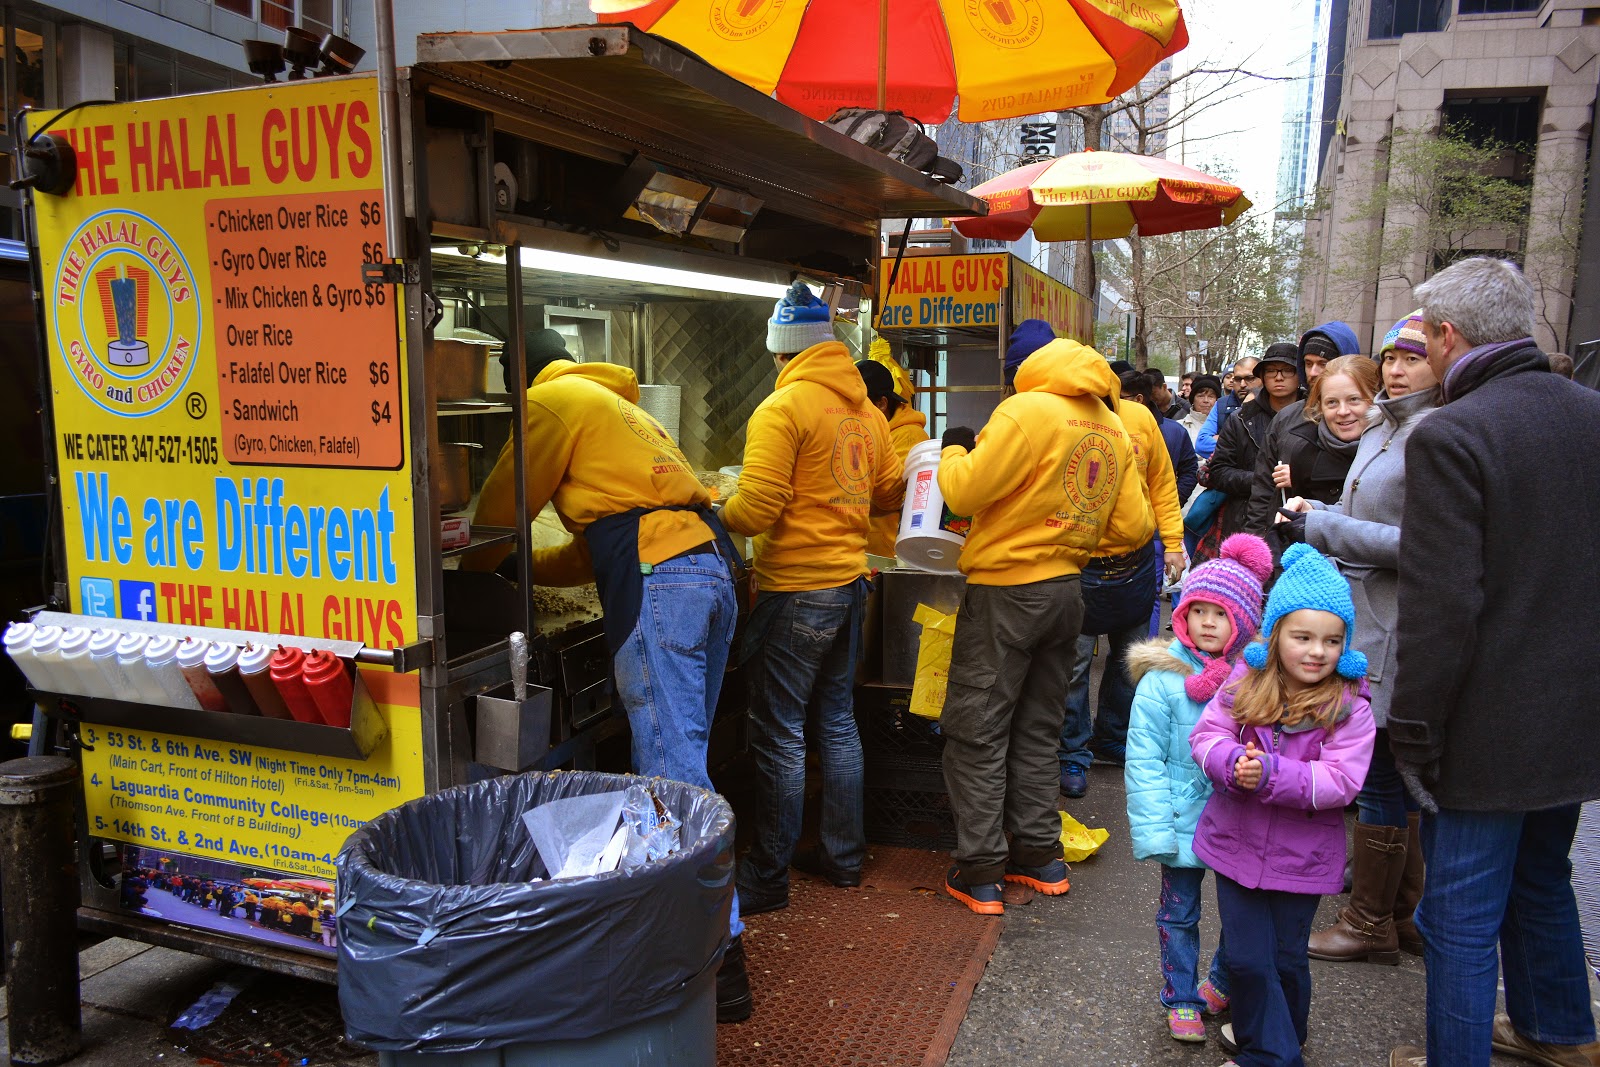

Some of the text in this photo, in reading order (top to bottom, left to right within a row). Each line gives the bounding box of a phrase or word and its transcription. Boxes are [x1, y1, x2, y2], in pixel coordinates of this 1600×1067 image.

[1130, 2, 1163, 27] GUYS
[48, 100, 373, 198] HE HALAL GUYS
[1039, 186, 1151, 203] THE HALAL GUYS
[218, 201, 381, 233] Chicken Over Rice $6
[59, 220, 190, 306] THE HALAL GUYS
[222, 241, 383, 276] Gyro Over Rice $6
[952, 257, 1004, 292] GUYS
[225, 283, 385, 312] Mix Chicken & Gyro $6
[882, 296, 1000, 326] are Differen
[227, 324, 293, 346] Over Rice
[70, 336, 191, 404] GYRO and CHICKEN
[229, 361, 390, 387] Falafel Over Rice $6
[233, 399, 392, 426] Sandwich $4
[1066, 419, 1078, 427] WE
[1079, 420, 1091, 429] ARE
[1091, 422, 1123, 439] DIFFERENT
[63, 433, 219, 465] WE CATER 347-527-1505
[234, 434, 360, 459] (Gyro, Chicken, Falafel)
[1067, 437, 1115, 485] THE HALAL GUYS
[75, 471, 398, 585] We are Different
[1055, 510, 1070, 519] 6th
[322, 594, 405, 650] GUYS
[107, 731, 124, 748] 53
[128, 735, 147, 751] St.
[151, 738, 162, 753] &
[166, 740, 189, 758] 6th
[194, 744, 225, 763] Ave.
[229, 749, 252, 766] SW
[255, 756, 287, 774] (Night
[290, 761, 316, 777] Time
[319, 765, 344, 784] Only
[346, 769, 401, 792] 7pm-4am)
[109, 754, 285, 796] (Main Cart, Front of Hilton Hotel)
[111, 775, 180, 801] Laguardia
[184, 787, 266, 818] Community
[334, 782, 375, 798] 7pm-5am)
[110, 794, 302, 839] (Thomson Ave. Front of B Building)
[113, 819, 146, 838] 14th
[150, 825, 172, 843] St.
[177, 830, 189, 846] &
[195, 833, 223, 851] 2nd
